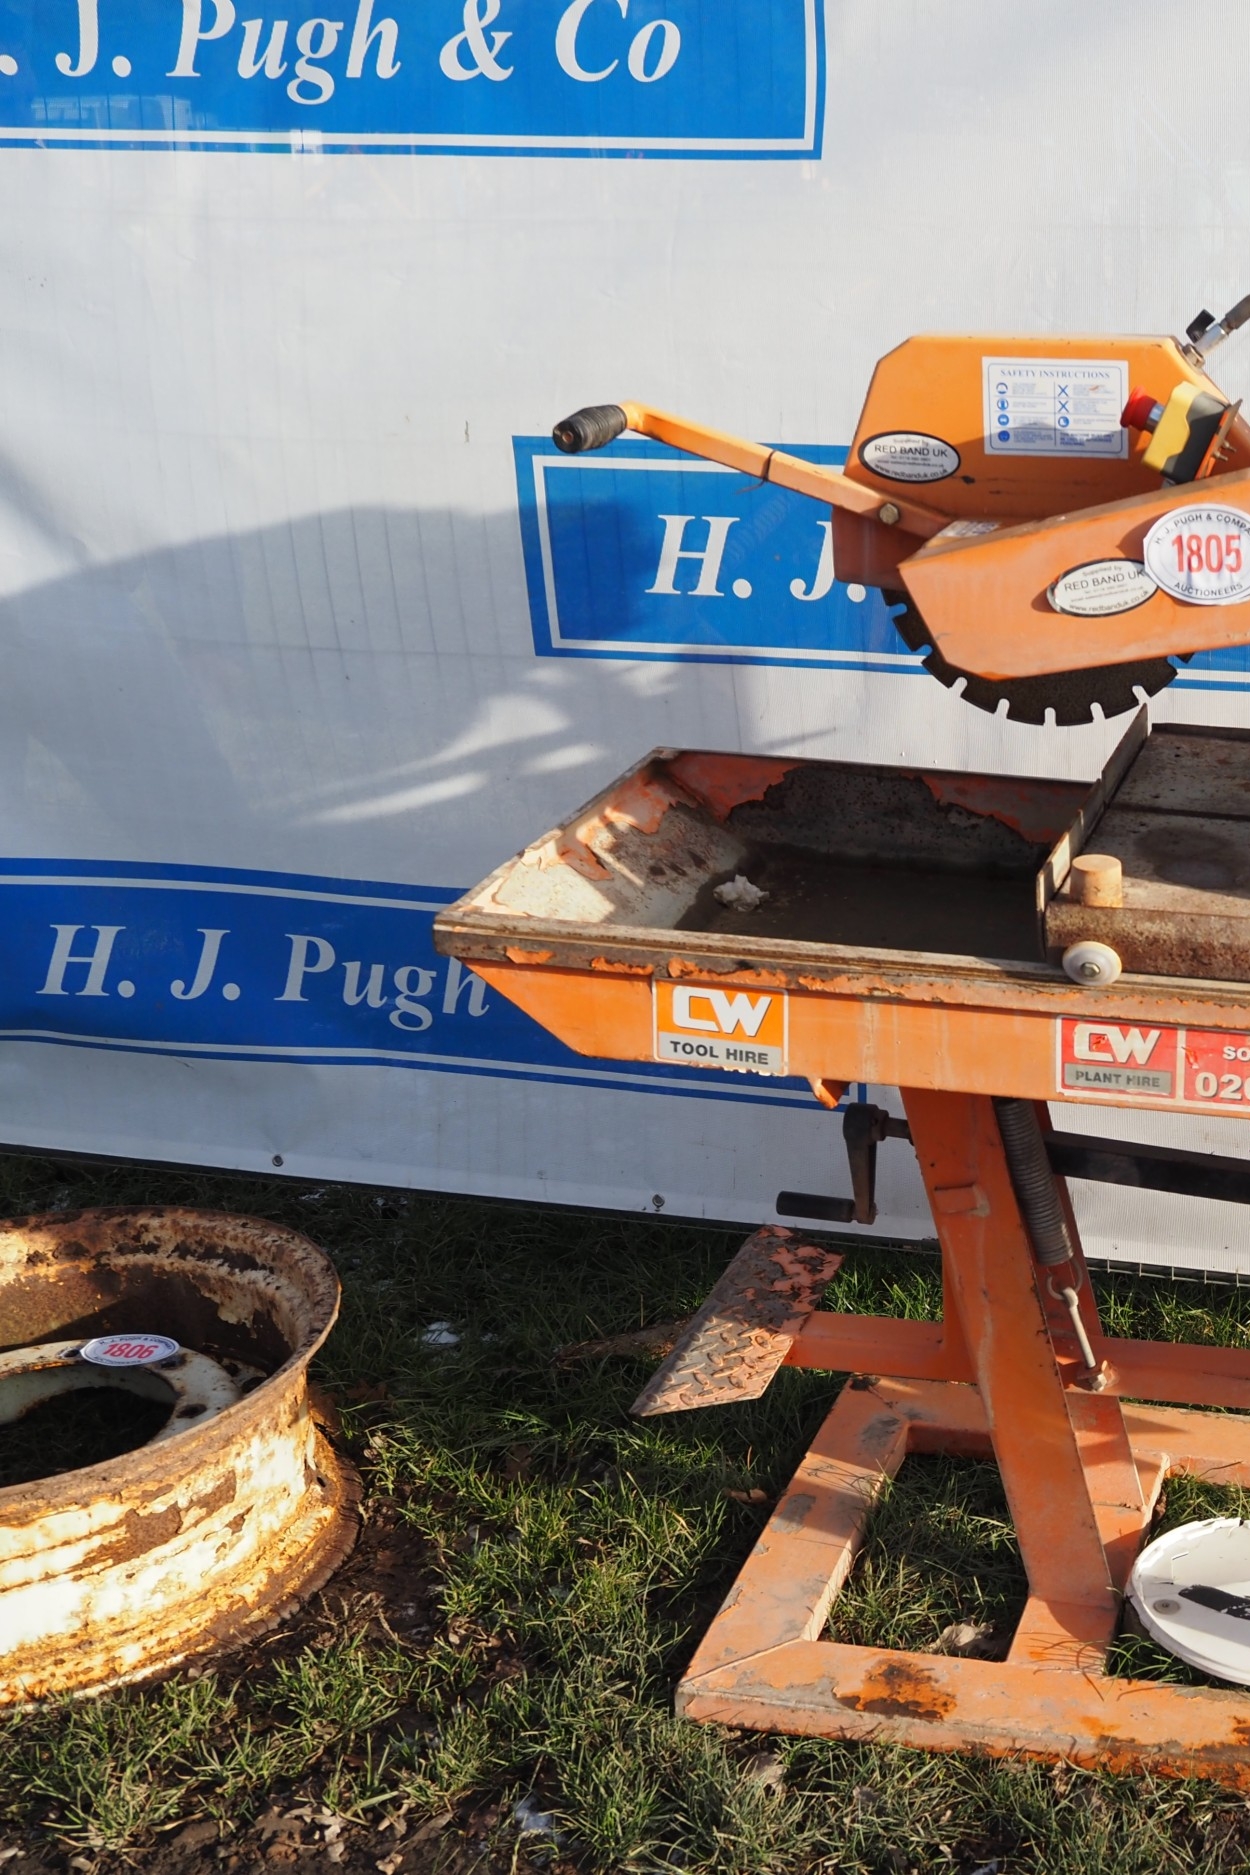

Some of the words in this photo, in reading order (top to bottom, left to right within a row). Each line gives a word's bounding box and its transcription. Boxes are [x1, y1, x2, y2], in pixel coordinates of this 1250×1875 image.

[55, 0, 132, 78] J.
[166, 0, 401, 105] Pugh
[439, 0, 514, 82] &
[555, 0, 681, 82] Co
[1000, 369, 1036, 377] SAFETY
[1039, 370, 1111, 379] INSTRUCTIONS
[874, 444, 897, 454] RED
[900, 446, 930, 456] BAND
[932, 448, 948, 458] UK
[1173, 513, 1202, 528] PUGH
[1206, 513, 1213, 521] &
[644, 513, 753, 599] H.
[789, 520, 867, 603] J.
[1172, 533, 1243, 573] 1805
[1064, 580, 1089, 592] RED
[1092, 573, 1125, 587] BAND
[1127, 568, 1146, 580] UK
[1174, 581, 1244, 597] AUCTIONEERS
[35, 923, 136, 999] H.
[170, 928, 241, 1001] J.
[273, 933, 490, 1032] Pugh
[672, 985, 773, 1037] CW
[669, 1040, 719, 1059] TOOL
[725, 1047, 769, 1065] HIRE
[1073, 1023, 1161, 1065] CW
[1074, 1070, 1122, 1086] PLANT
[1126, 1072, 1161, 1089] HIRE
[102, 1342, 160, 1359] 1806
